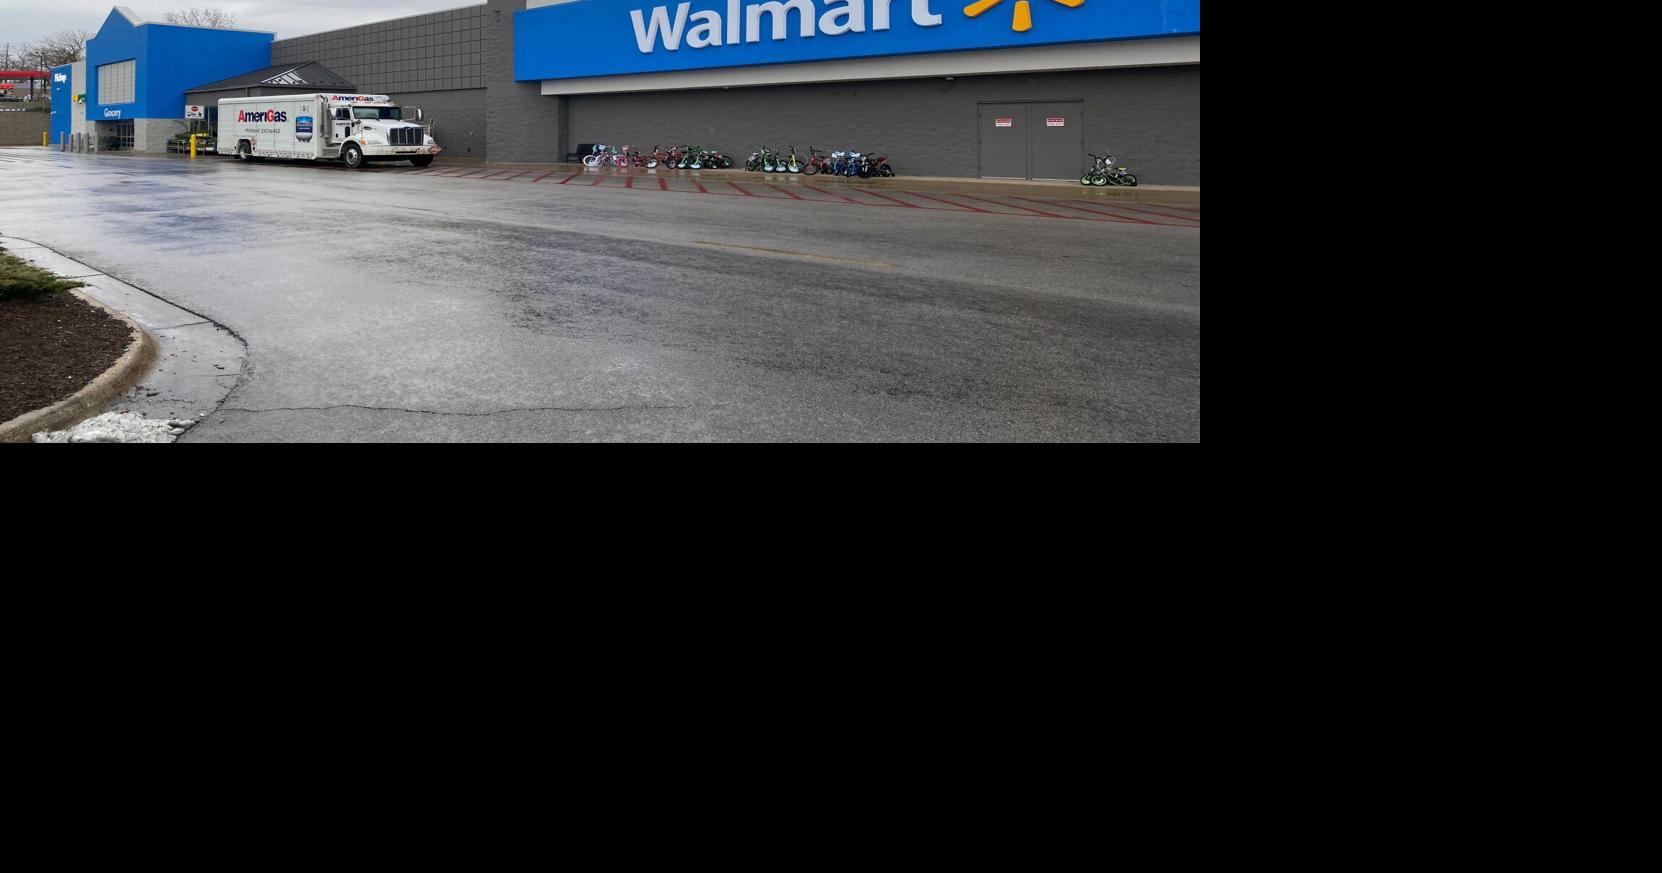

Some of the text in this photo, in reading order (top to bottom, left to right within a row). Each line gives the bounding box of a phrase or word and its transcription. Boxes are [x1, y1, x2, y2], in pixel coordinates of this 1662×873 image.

[630, 0, 942, 53] Walmart
[332, 94, 374, 102] AmeriGas
[238, 109, 287, 123] AmeriGas
